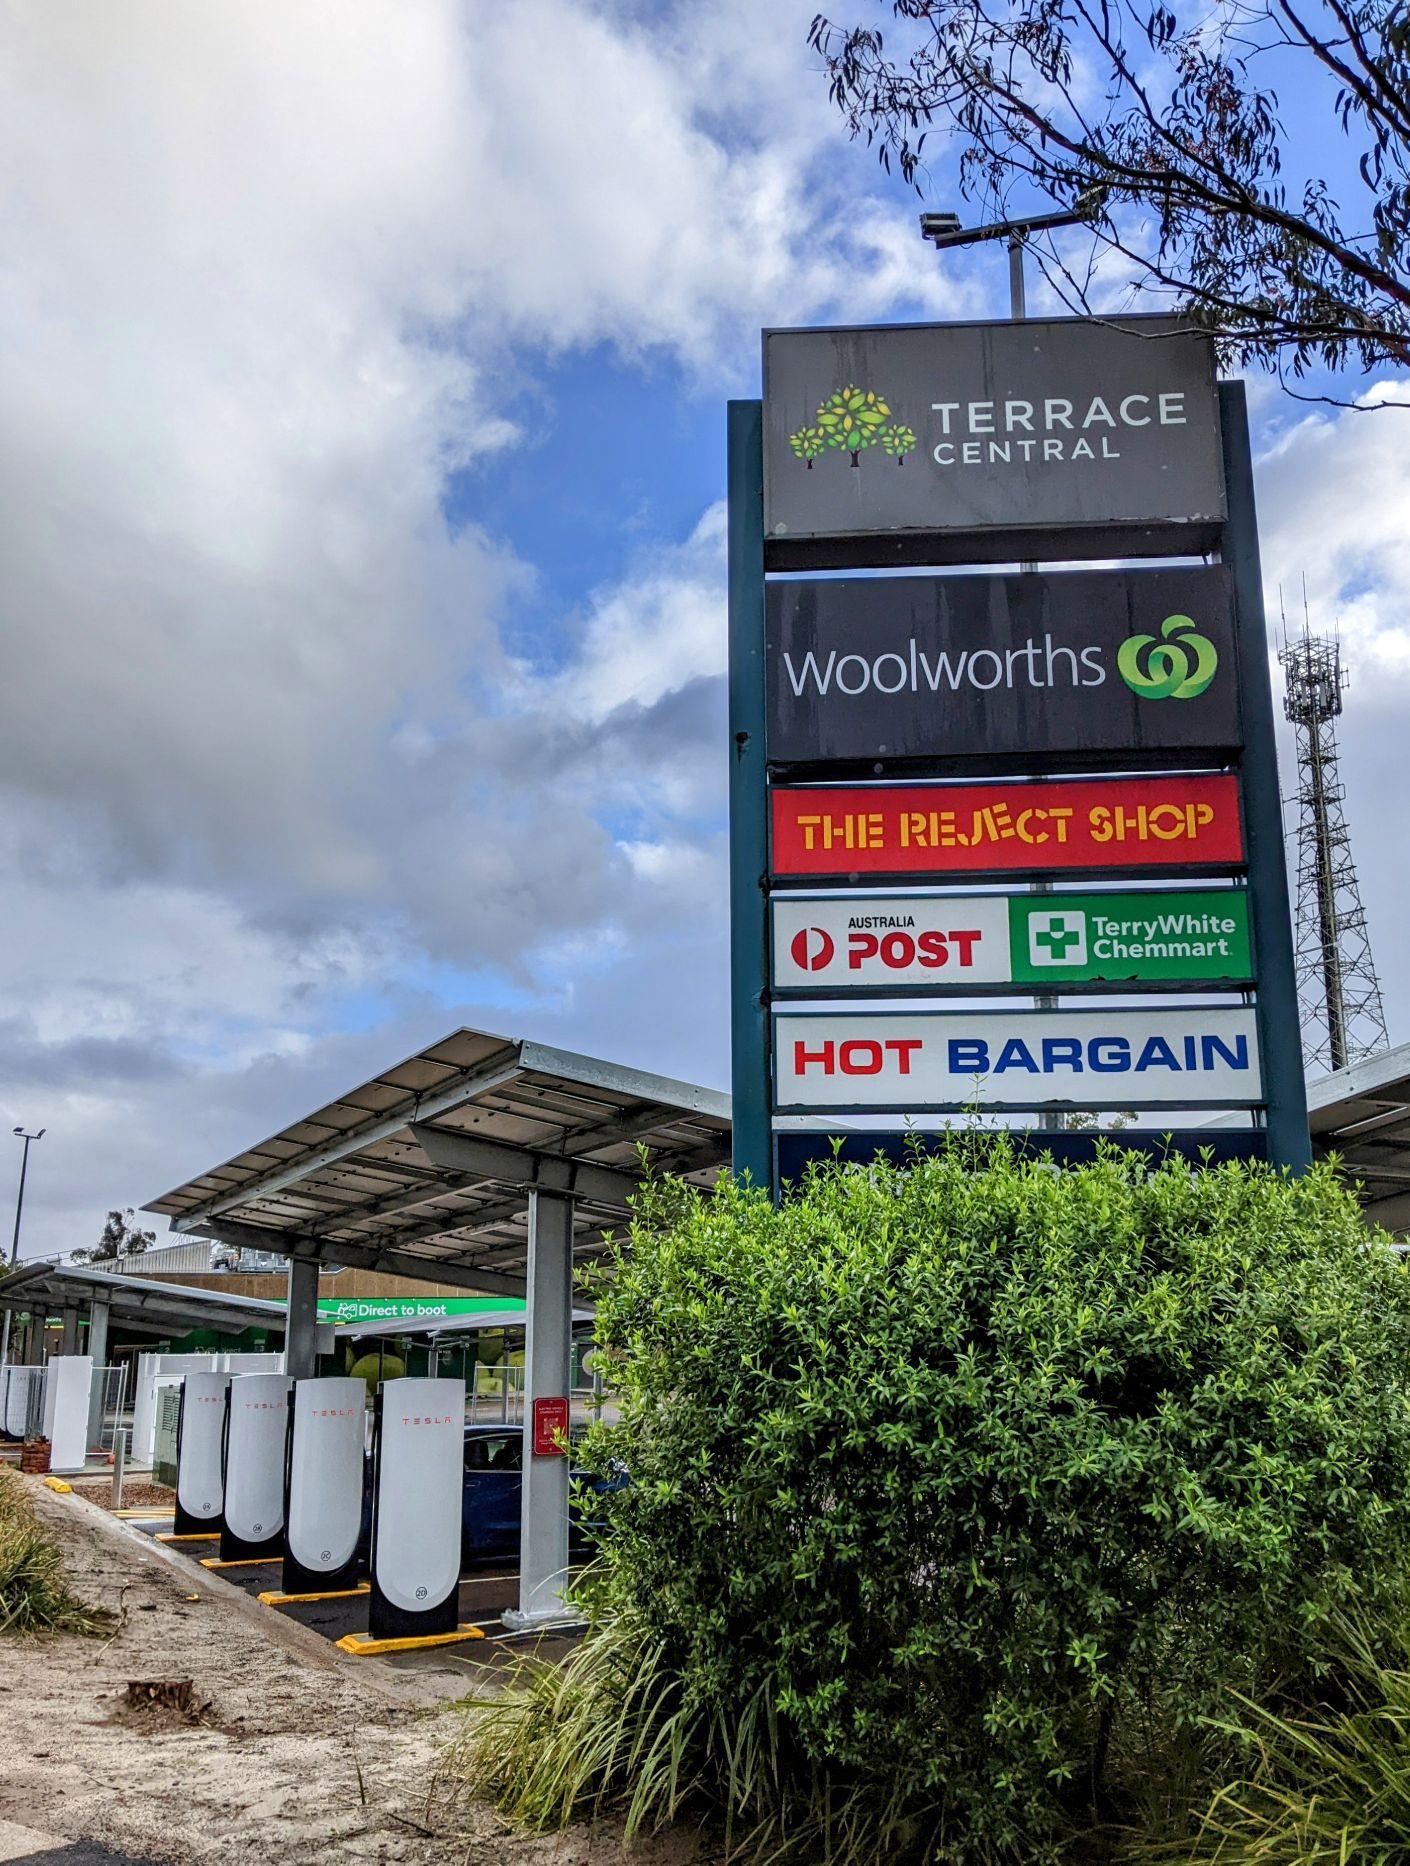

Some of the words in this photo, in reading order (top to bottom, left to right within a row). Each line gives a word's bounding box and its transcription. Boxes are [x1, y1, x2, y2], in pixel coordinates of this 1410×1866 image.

[932, 392, 1187, 434] TERRACE
[933, 436, 1120, 465] CENTRAL
[783, 633, 1106, 697] Woolworths
[797, 813, 884, 850] THE
[901, 803, 1073, 847] REJECT
[1090, 804, 1214, 843] SHOP
[848, 916, 915, 928] AUSTRALIA
[1092, 914, 1236, 941] TerryWhite
[848, 930, 982, 969] POST
[1093, 938, 1229, 959] Chemmart
[794, 1039, 923, 1076] HOT
[947, 1035, 1249, 1074] BARGAIN
[358, 1304, 398, 1316] Direct
[401, 1305, 415, 1315] to
[417, 1303, 447, 1316] boot
[312, 1408, 354, 1416] TESLA
[402, 1415, 452, 1424] TESLA
